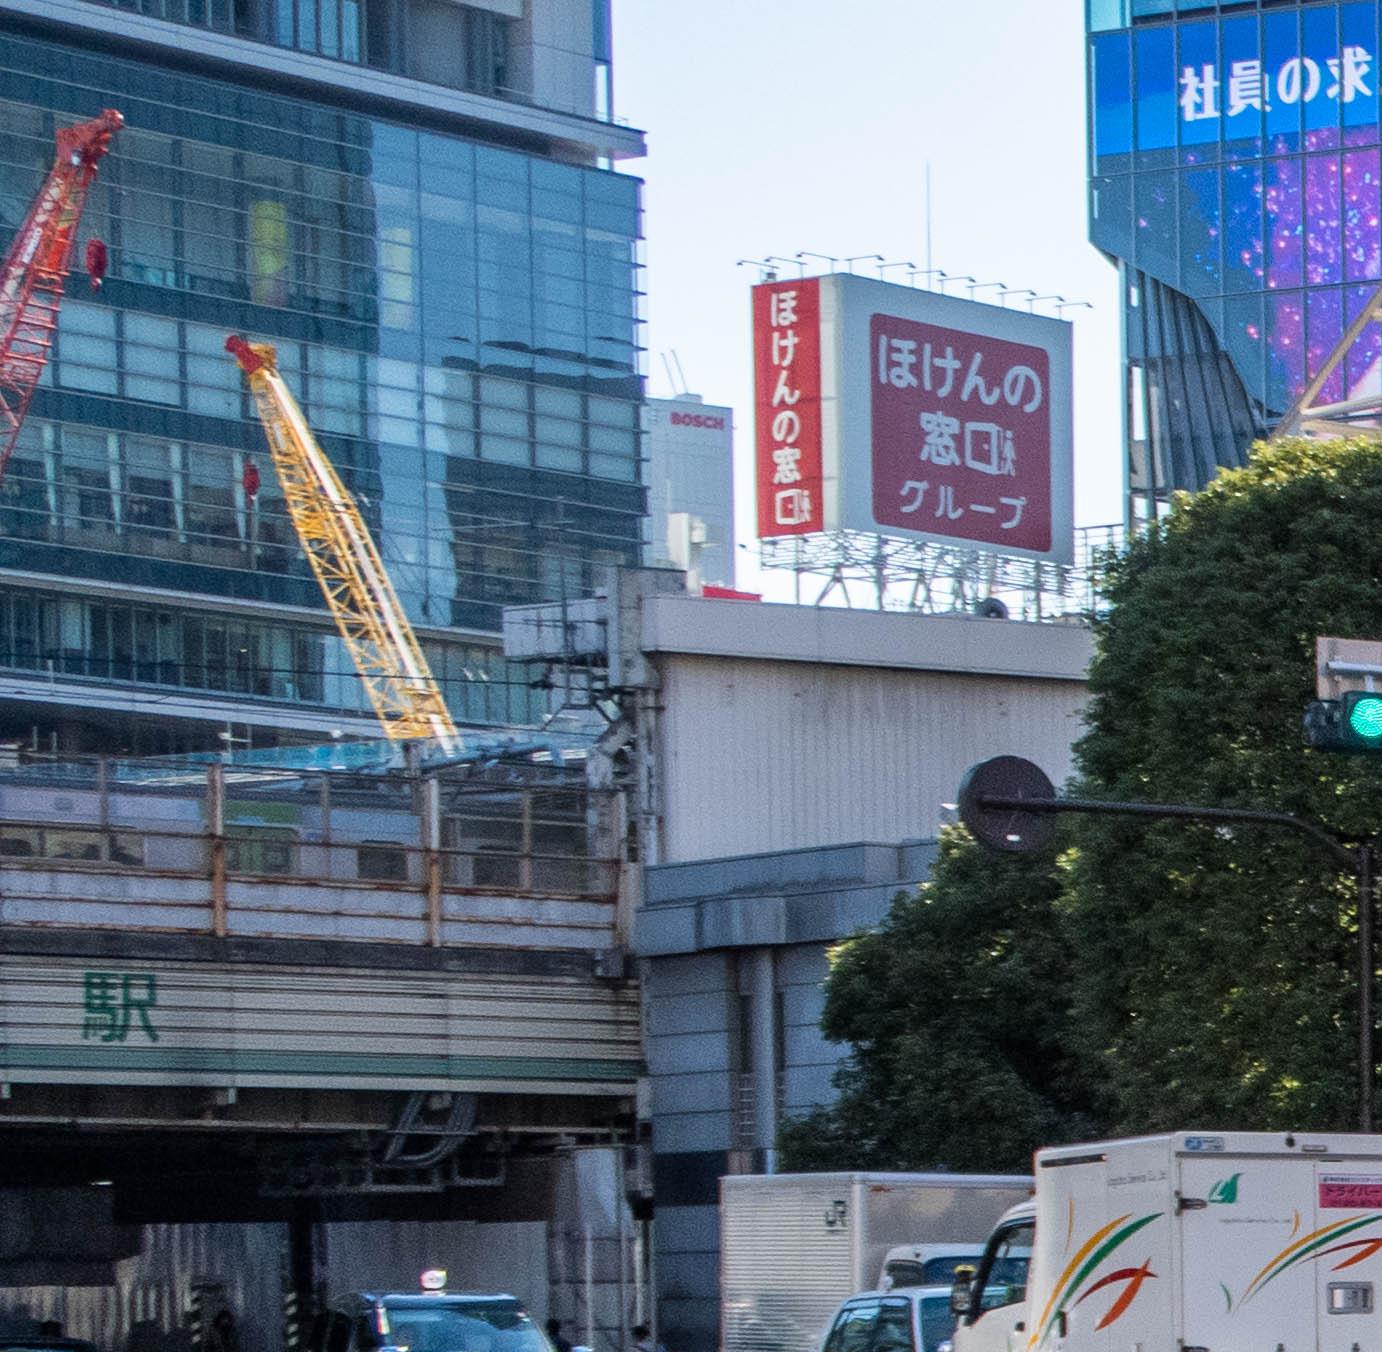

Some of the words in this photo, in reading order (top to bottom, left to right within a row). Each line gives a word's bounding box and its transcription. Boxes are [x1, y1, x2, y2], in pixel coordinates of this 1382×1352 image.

[878, 334, 1043, 413] ほけんの
[671, 412, 725, 430] BOSCH
[900, 480, 1027, 530] グループ
[82, 971, 159, 1043] 駅
